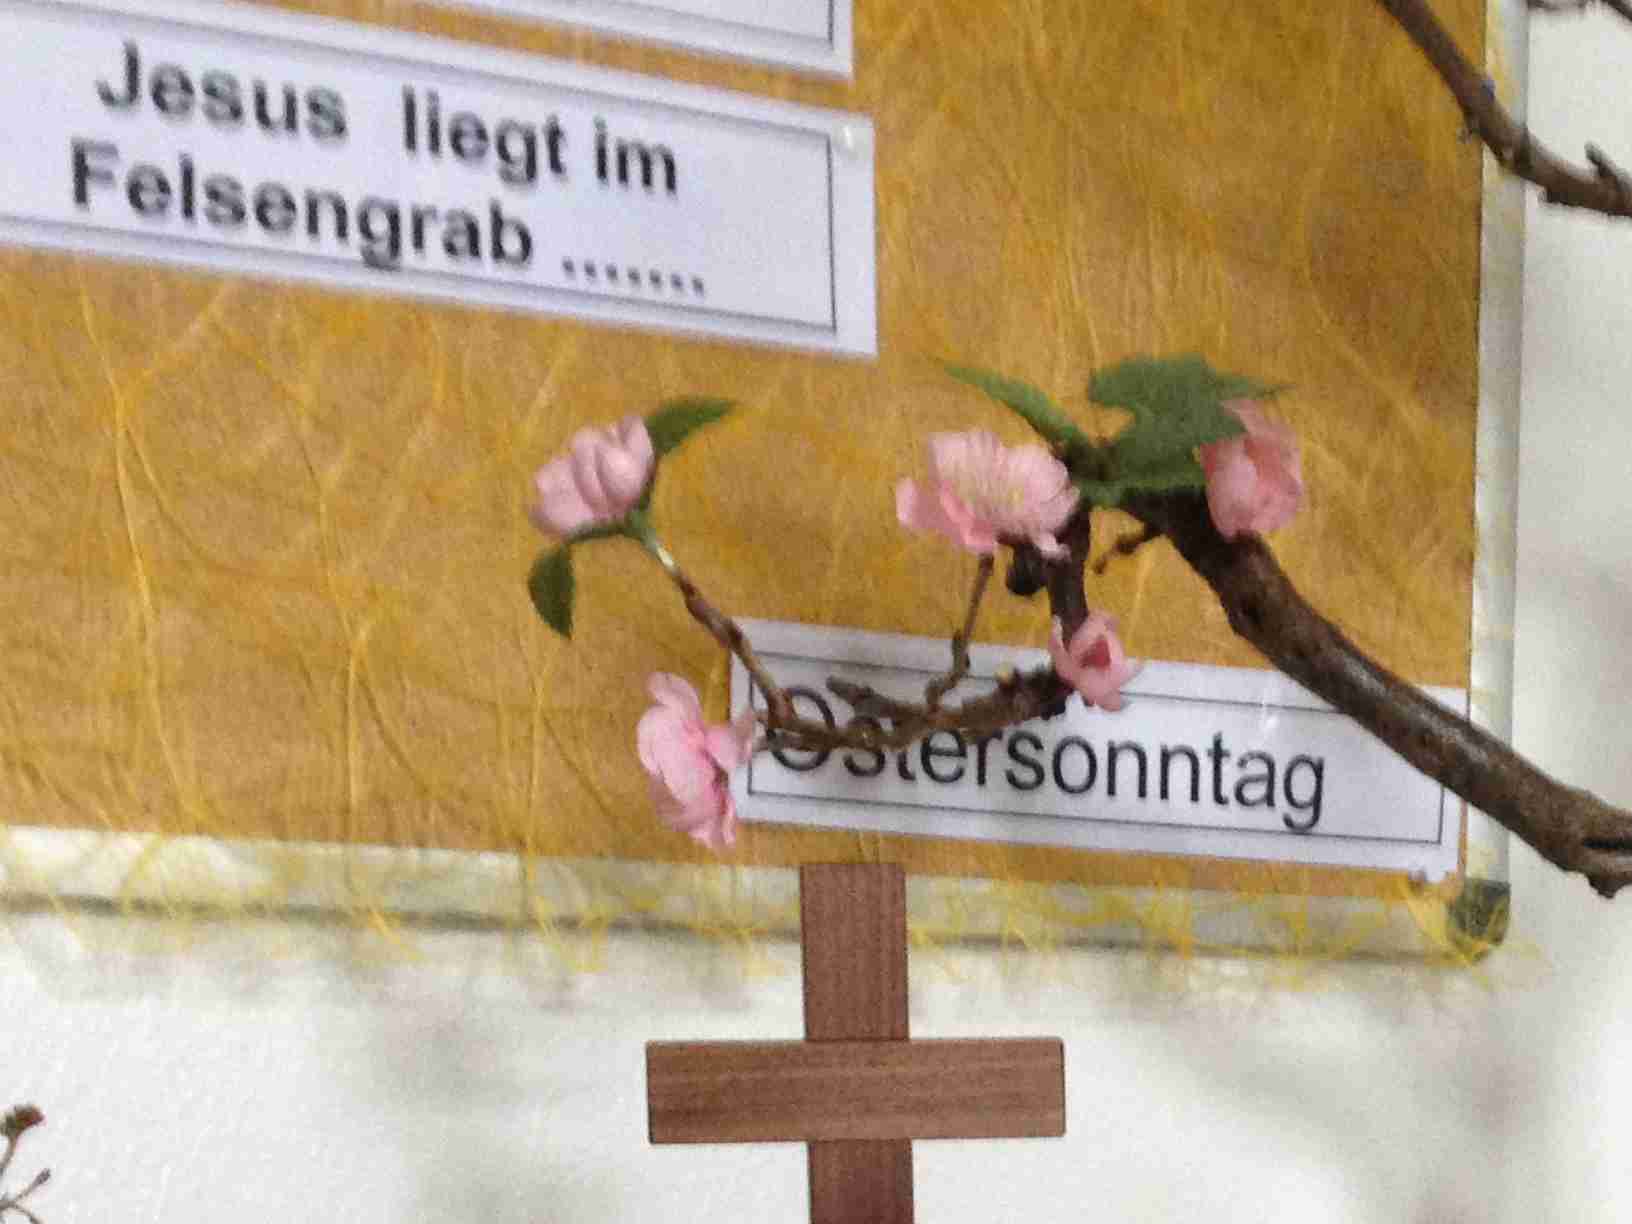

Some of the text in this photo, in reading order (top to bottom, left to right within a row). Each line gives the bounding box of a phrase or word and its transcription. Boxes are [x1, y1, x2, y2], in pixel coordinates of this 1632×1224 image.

[94, 40, 679, 196] Jesus liegt im
[69, 136, 534, 269] Felsengrab
